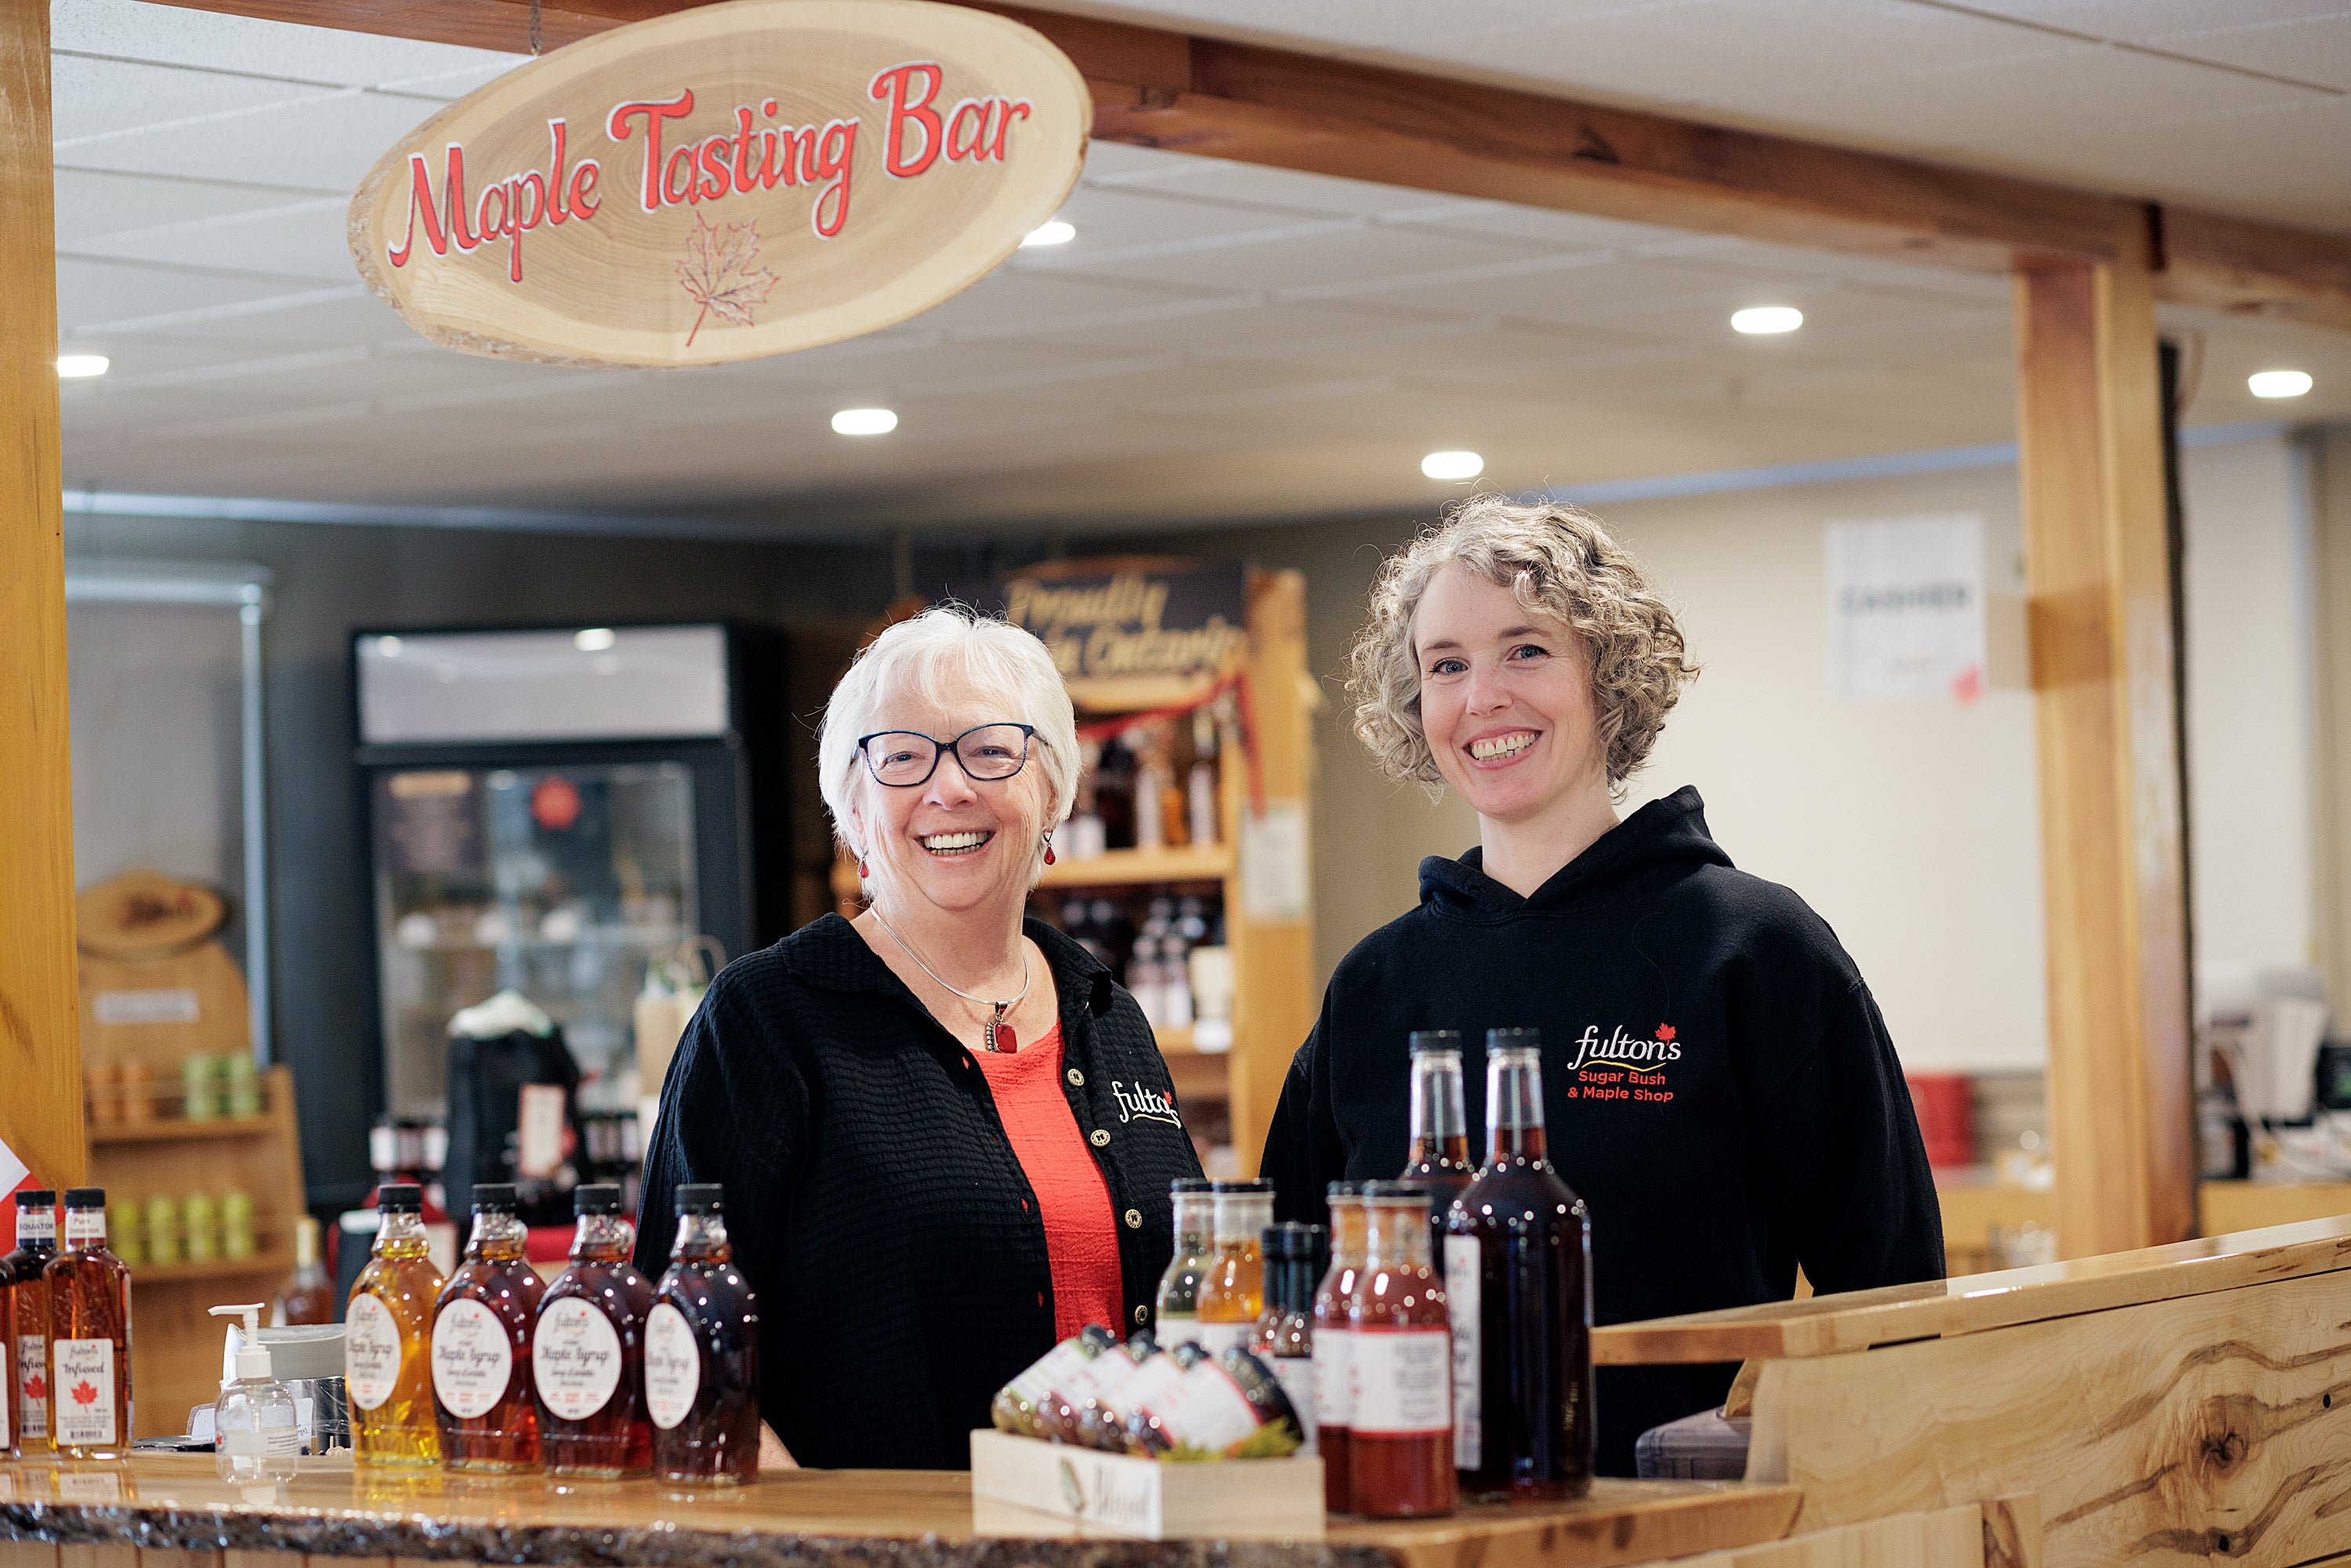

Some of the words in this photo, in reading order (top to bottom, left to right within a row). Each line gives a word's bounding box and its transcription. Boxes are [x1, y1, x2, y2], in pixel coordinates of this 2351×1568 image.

[386, 117, 602, 283] Maple
[607, 88, 861, 240] Tasting
[868, 60, 1034, 180] Bar
[1578, 1070, 1624, 1085] Sugar
[1628, 1071, 1666, 1085] Bush
[1567, 1086, 1578, 1098] &
[1583, 1086, 1629, 1101] Maple
[1634, 1088, 1674, 1103] Shop
[63, 1362, 105, 1378] Infused
